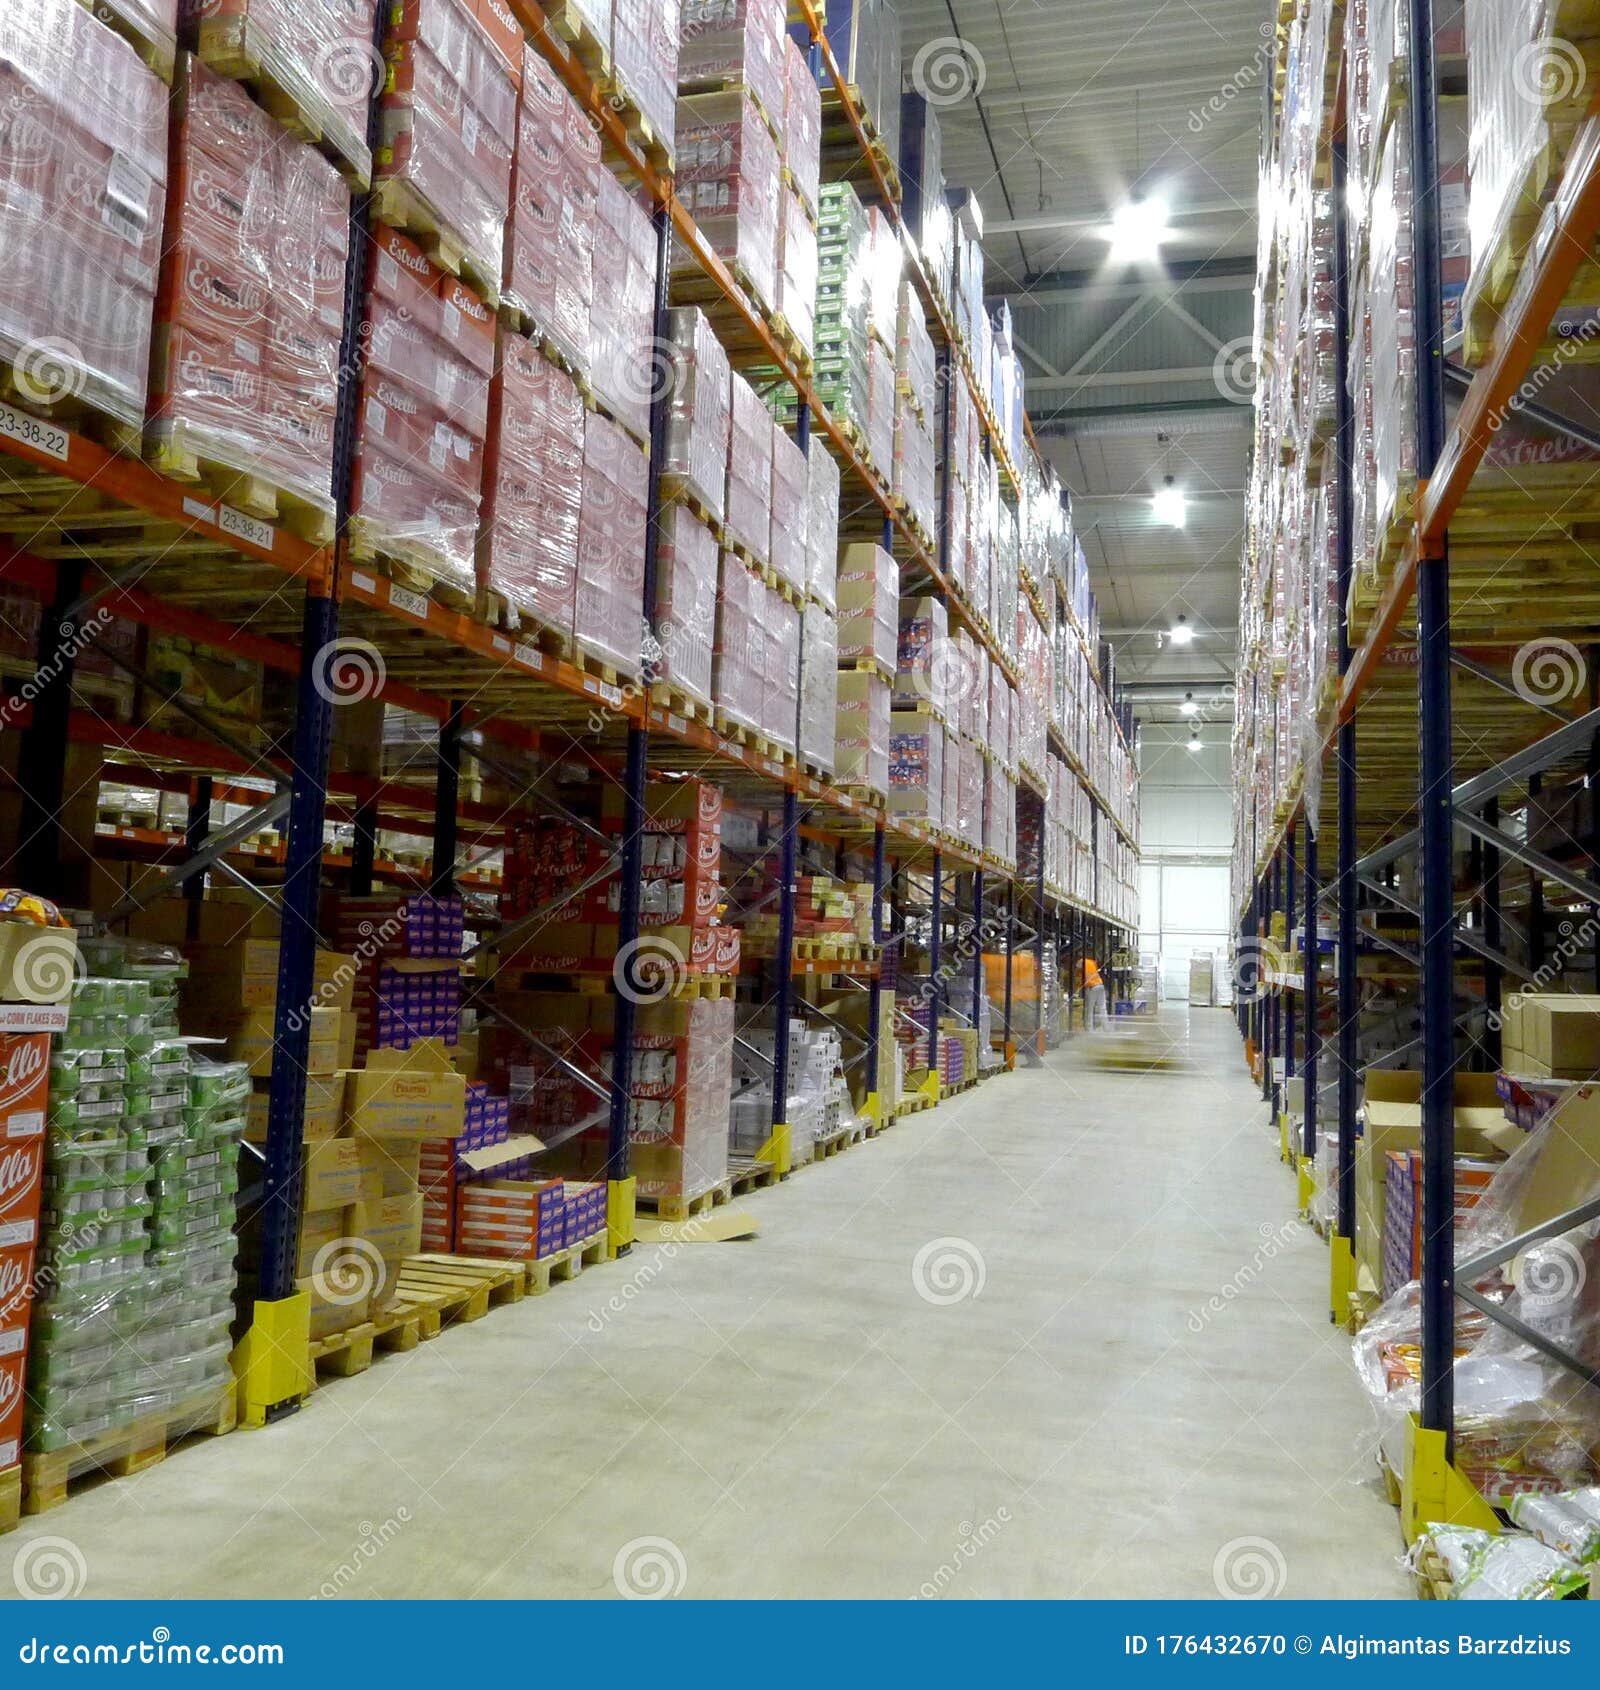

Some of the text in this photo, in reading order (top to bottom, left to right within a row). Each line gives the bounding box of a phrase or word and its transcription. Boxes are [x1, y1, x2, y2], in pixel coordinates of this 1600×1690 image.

[388, 237, 430, 276] Estrella
[452, 287, 488, 321] Estrella
[222, 511, 271, 545] 23-38-21
